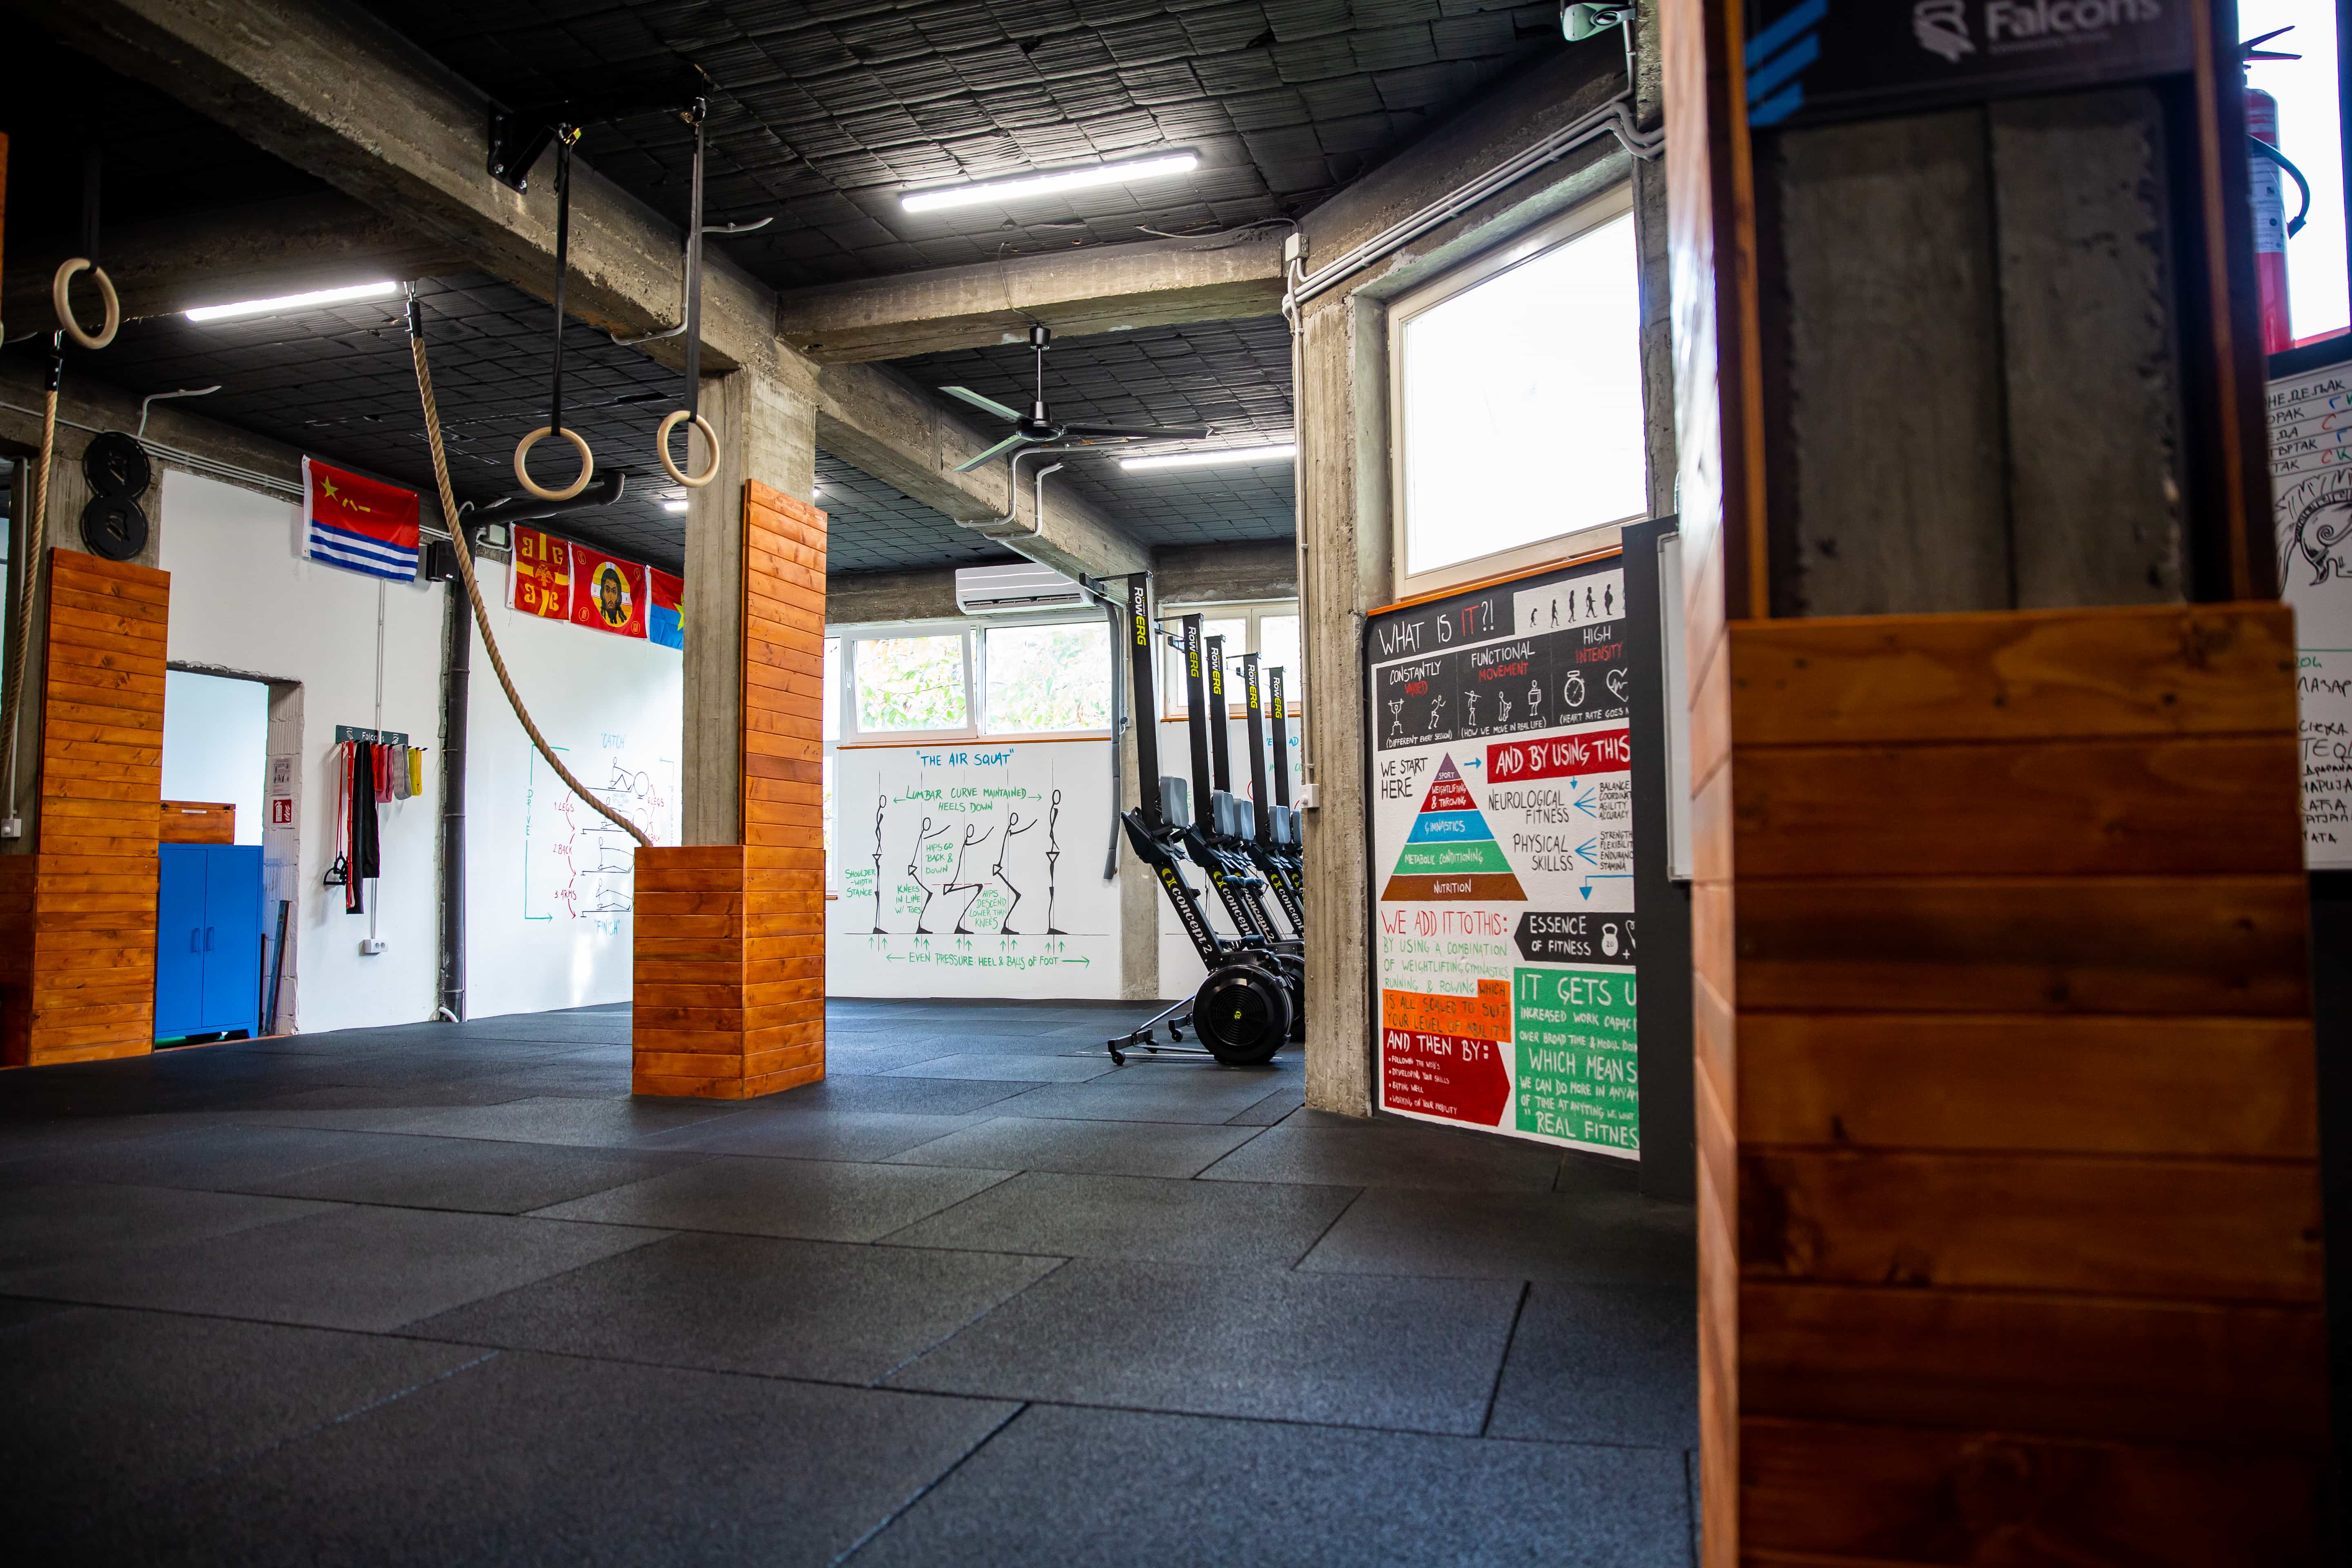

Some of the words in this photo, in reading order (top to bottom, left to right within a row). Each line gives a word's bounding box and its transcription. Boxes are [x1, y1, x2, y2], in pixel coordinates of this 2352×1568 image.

[1379, 621, 1425, 655] WHAT
[1437, 614, 1452, 643] IS
[1584, 625, 1611, 645] HIGH
[1471, 641, 1535, 668] FUNCTIONAL
[1576, 640, 1623, 664] INTENSITY
[1390, 660, 1441, 685] CONSTANTLY
[1479, 660, 1528, 682] MOVEMENT
[1585, 709, 1602, 720] RATE
[1605, 707, 1623, 717] GOES
[1461, 727, 1480, 739] (HOW
[1480, 726, 1490, 735] WE
[1493, 724, 1508, 733] MOVE
[1510, 722, 1516, 731] IN
[1531, 716, 1546, 729] LIFE)
[362, 732, 385, 742] Falcos
[1386, 735, 1418, 748] (DIFFERENT
[916, 750, 942, 766] "THE
[948, 752, 969, 766] AIR
[973, 748, 1014, 766] SQUAT"
[1496, 746, 1523, 776] AND
[1528, 743, 1548, 771] BY
[1552, 737, 1590, 766] USING
[1592, 735, 1630, 762] THIS
[1381, 760, 1396, 777] WE
[1400, 757, 1428, 776] START
[906, 785, 942, 800] LUMBAR
[951, 788, 978, 798] CURVE
[983, 788, 1027, 800] MAINTAINED
[1382, 777, 1413, 800] HERE
[1432, 783, 1466, 795] WEIGHTLIFTING
[1600, 781, 1630, 792] BALANCE
[938, 802, 966, 812] HEELS
[969, 801, 993, 811] DOWN
[1431, 796, 1437, 809] &
[1439, 796, 1466, 807] THROWING
[1489, 788, 1565, 810] NEUROLOGICAL
[1599, 801, 1627, 811] AGILITY
[1526, 808, 1569, 824] FITNESS
[926, 843, 942, 852] HIPS
[1513, 833, 1568, 854] PHYSICAL
[925, 853, 946, 862] BACK
[947, 853, 953, 863] &
[845, 869, 876, 880] SHOULDER
[925, 864, 948, 874] DOWN
[846, 886, 873, 898] STANCE
[897, 884, 920, 894] KNEES
[982, 890, 999, 898] HIPS
[1434, 878, 1472, 894] NUTRITION
[895, 894, 903, 904] IN
[904, 894, 921, 904] LINE
[976, 898, 1007, 907] DESCEND
[895, 904, 904, 915] W/
[908, 905, 922, 915] TOES
[969, 909, 993, 918] LOWER
[1223, 887, 1252, 938] concept
[1279, 888, 1305, 933] concept
[975, 917, 998, 930] KNEES
[1173, 887, 1207, 945] concept
[1203, 944, 1212, 954] 2
[1381, 910, 1406, 935] WE
[1414, 911, 1437, 937] ADD
[1443, 911, 1454, 935] IT
[1457, 911, 1473, 935] TO
[1473, 911, 1508, 936] THIS:
[1530, 915, 1587, 934] ESSENCE
[1383, 936, 1393, 953] BY
[1400, 939, 1429, 954] USING
[1436, 942, 1441, 956] A
[1447, 941, 1507, 958] COMBINATION
[1532, 940, 1542, 951] OF
[1548, 939, 1591, 956] FITNESS
[909, 952, 931, 962] EVEN
[978, 955, 997, 967] HEEL
[999, 957, 1004, 966] &
[1006, 955, 1026, 970] BALLS
[1028, 956, 1038, 967] OF
[1040, 956, 1059, 966] FOOT
[1384, 958, 1395, 972] OF
[1385, 974, 1418, 993] RUNNING
[1440, 978, 1474, 993] ROWING
[1479, 983, 1506, 997] WHICH
[1522, 974, 1542, 1000] IT
[1558, 977, 1612, 1006] GETS
[1386, 994, 1395, 1009] IS
[1401, 996, 1415, 1009] ALL
[1423, 998, 1456, 1014] SCALED
[1461, 1001, 1474, 1013] TO
[1483, 1003, 1508, 1018] SUIT
[1386, 1010, 1409, 1028] YOUR
[1414, 1016, 1443, 1033] LEVEL
[1447, 1021, 1461, 1033] OF
[1467, 1022, 1508, 1039] ABILITY
[1521, 1006, 1567, 1022] INCREASED
[1573, 1012, 1599, 1026] WORK
[1387, 1030, 1410, 1052] AND
[1416, 1034, 1452, 1055] THEN
[1461, 1040, 1489, 1062] BY:
[1519, 1031, 1539, 1043] OVER
[1543, 1033, 1566, 1046] BROAD
[1568, 1035, 1586, 1046] TIME
[1416, 1059, 1424, 1067] THE
[1529, 1047, 1576, 1076] WHICH
[1586, 1055, 1638, 1084] MEANS
[1411, 1084, 1424, 1094] WELL
[1520, 1076, 1531, 1089] WE
[1535, 1078, 1551, 1096] CAN
[1555, 1078, 1568, 1096] DO
[1570, 1081, 1591, 1096] MORE
[1595, 1085, 1605, 1098] IN
[1521, 1094, 1530, 1106] OF
[1534, 1096, 1555, 1110] TIME
